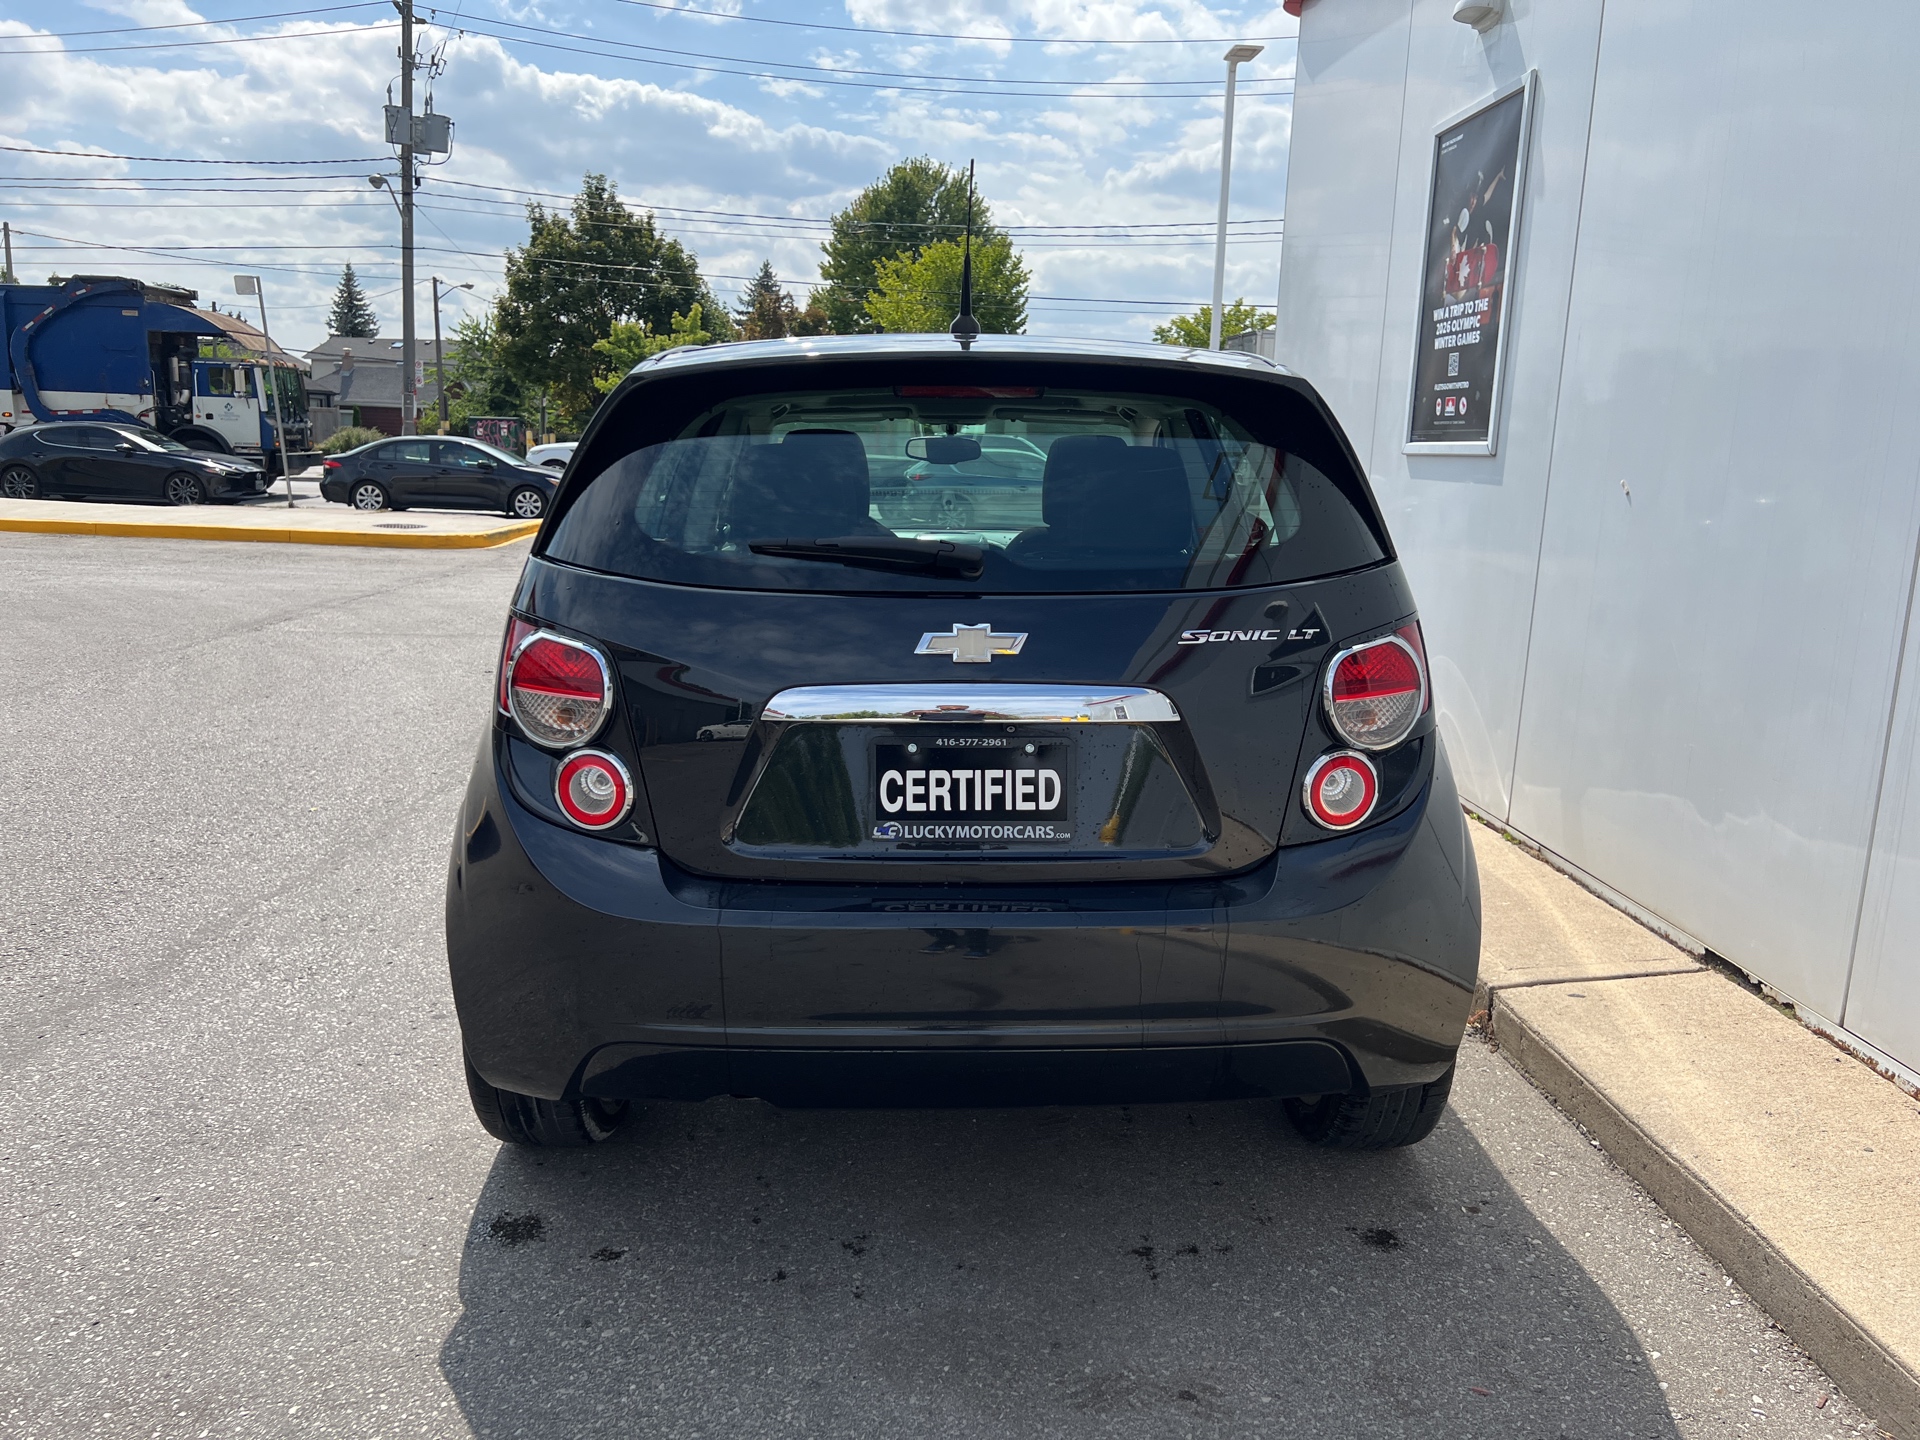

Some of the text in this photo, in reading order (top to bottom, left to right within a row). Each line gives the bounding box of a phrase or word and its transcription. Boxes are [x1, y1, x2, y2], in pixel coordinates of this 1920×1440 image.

[1433, 298, 1489, 321] WIN A TRIP TO THE
[1436, 315, 1481, 335] 2026 OLYMPIC
[1434, 330, 1481, 350] WINTER GAMES
[1178, 629, 1320, 645] SONIC LT
[936, 738, 1007, 747] 416-577-2961
[880, 769, 1061, 813] CERTIFIED
